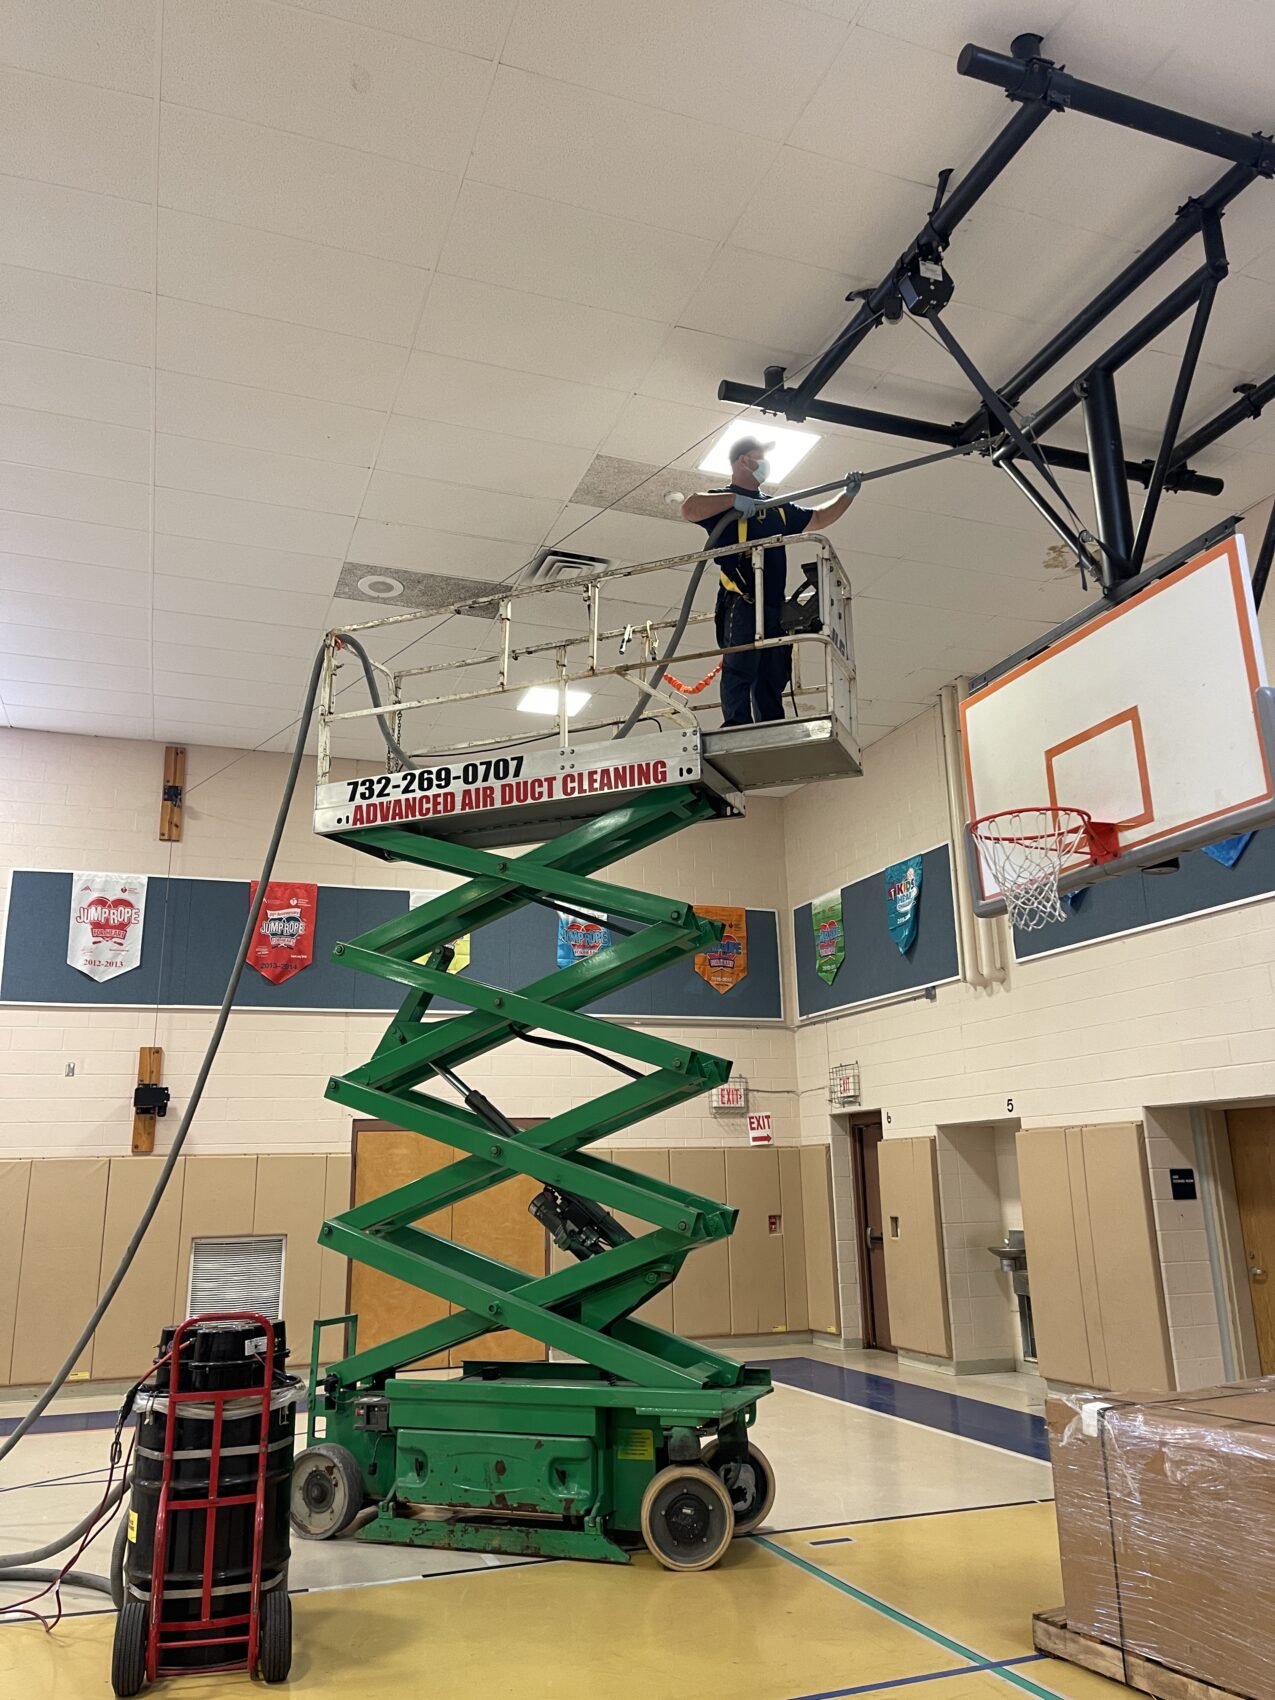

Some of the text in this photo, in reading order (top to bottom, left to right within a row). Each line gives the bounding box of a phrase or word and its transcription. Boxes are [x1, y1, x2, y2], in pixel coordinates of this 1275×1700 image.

[347, 756, 524, 802] 732-269-0707
[352, 760, 667, 826] ADVANCED AIR DUCT CLEANING
[76, 906, 141, 925] JUMP ROPE
[260, 920, 305, 936] JUMP ROPE
[84, 959, 124, 968] 2012-2013
[839, 1077, 850, 1095] EXIT
[720, 1087, 740, 1105] EXIT
[1007, 1098, 1014, 1113] 5
[749, 1114, 771, 1131] EXIT
